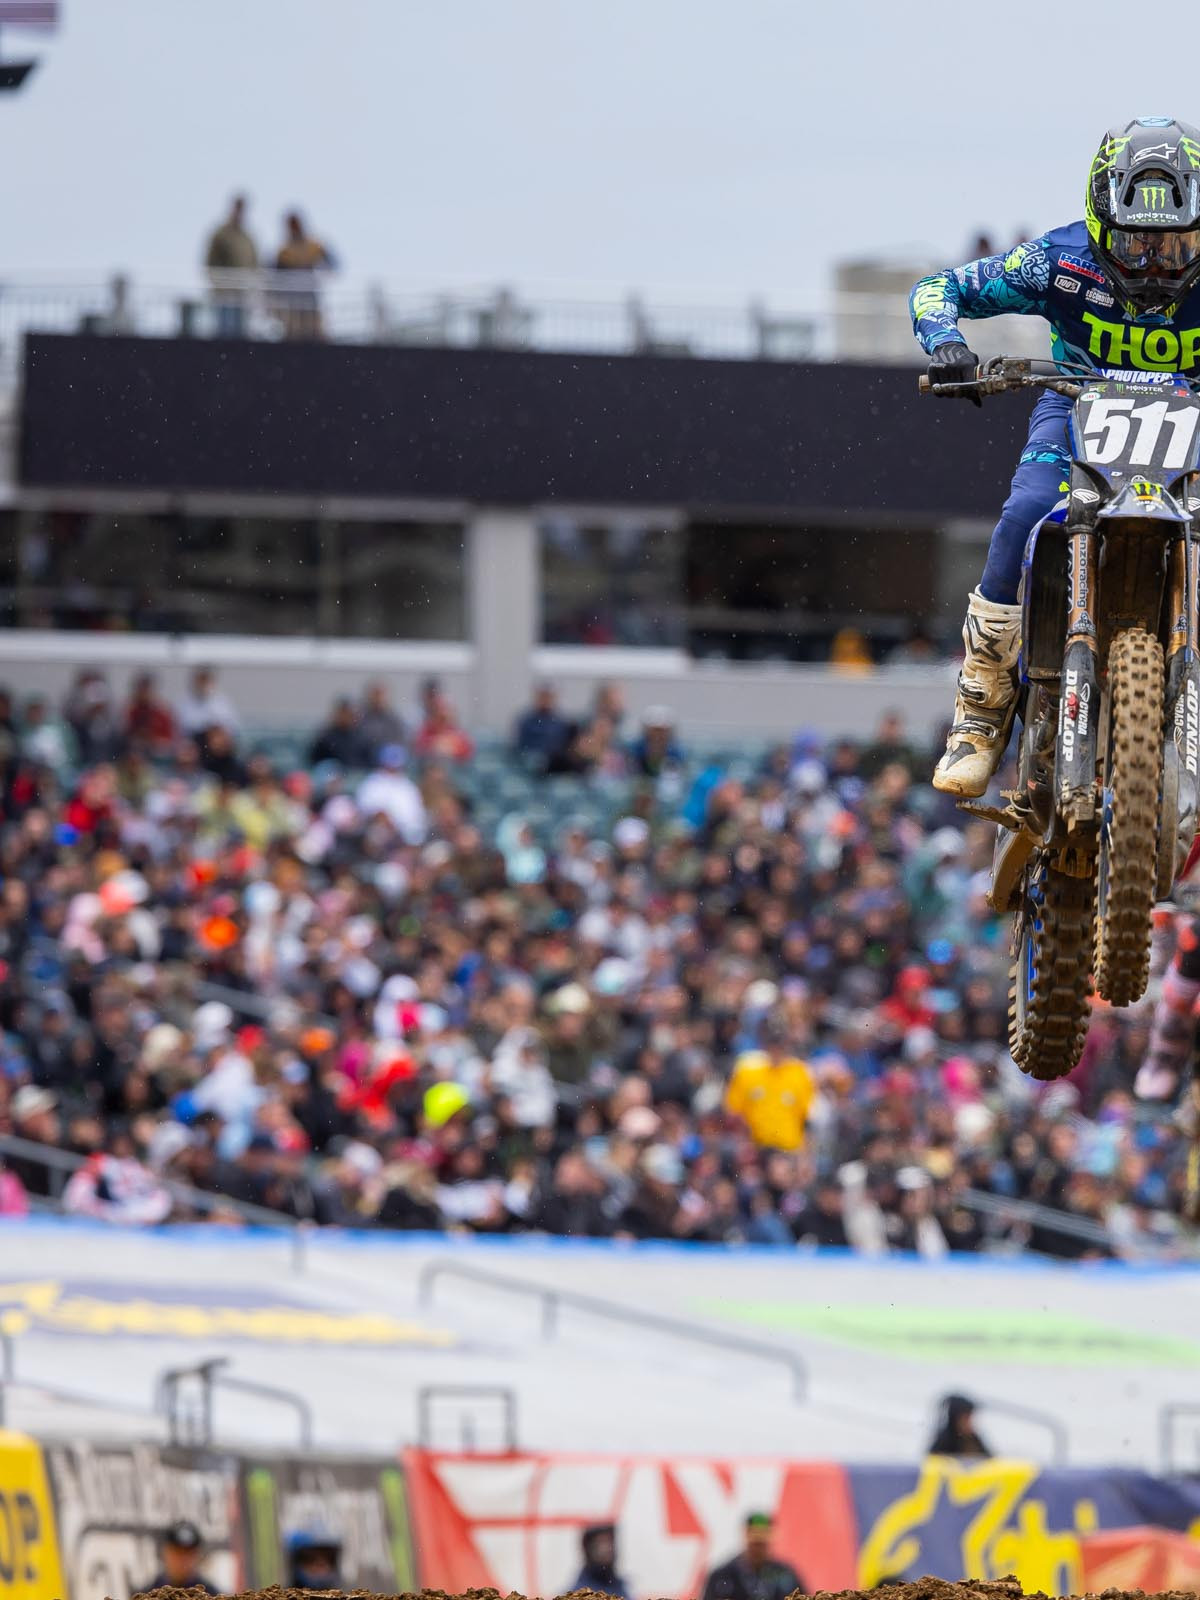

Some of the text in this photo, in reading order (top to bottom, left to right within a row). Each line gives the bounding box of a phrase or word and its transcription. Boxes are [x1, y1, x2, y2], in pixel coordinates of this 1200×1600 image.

[1126, 211, 1180, 222] MONSTER
[1058, 278, 1078, 291] 100%
[913, 277, 949, 320] THOR
[1104, 368, 1173, 385] PROTAPER
[1126, 385, 1164, 393] MONSTER
[1083, 398, 1200, 469] 511
[1077, 701, 1090, 736] CYCRA
[1186, 679, 1199, 776] DUNLOP
